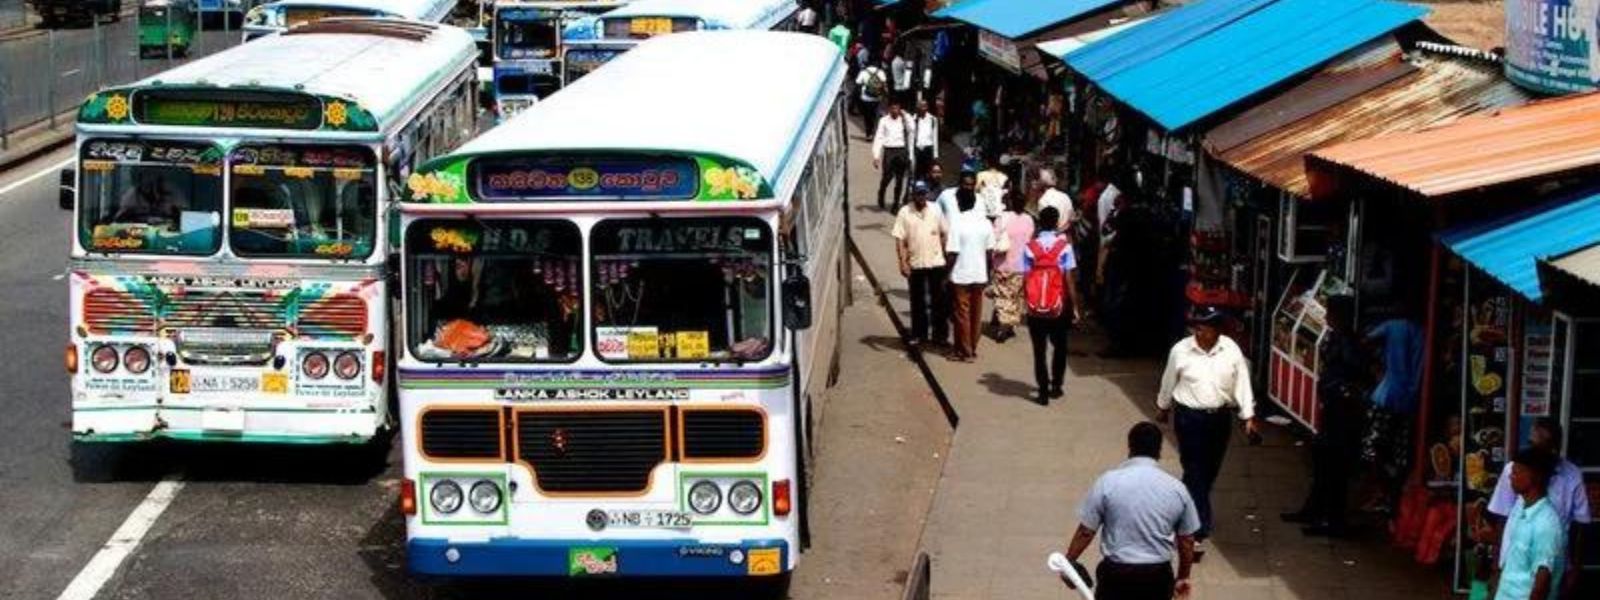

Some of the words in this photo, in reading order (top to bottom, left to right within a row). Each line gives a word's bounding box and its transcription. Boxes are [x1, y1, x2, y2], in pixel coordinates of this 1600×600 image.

[573, 172, 593, 184] 138
[618, 227, 742, 251] TRAVELS
[495, 388, 549, 400] LANKA
[556, 388, 611, 400] ASHOK
[616, 388, 689, 400] LEYLAND
[622, 512, 641, 526] NB
[657, 512, 691, 526] 1725
